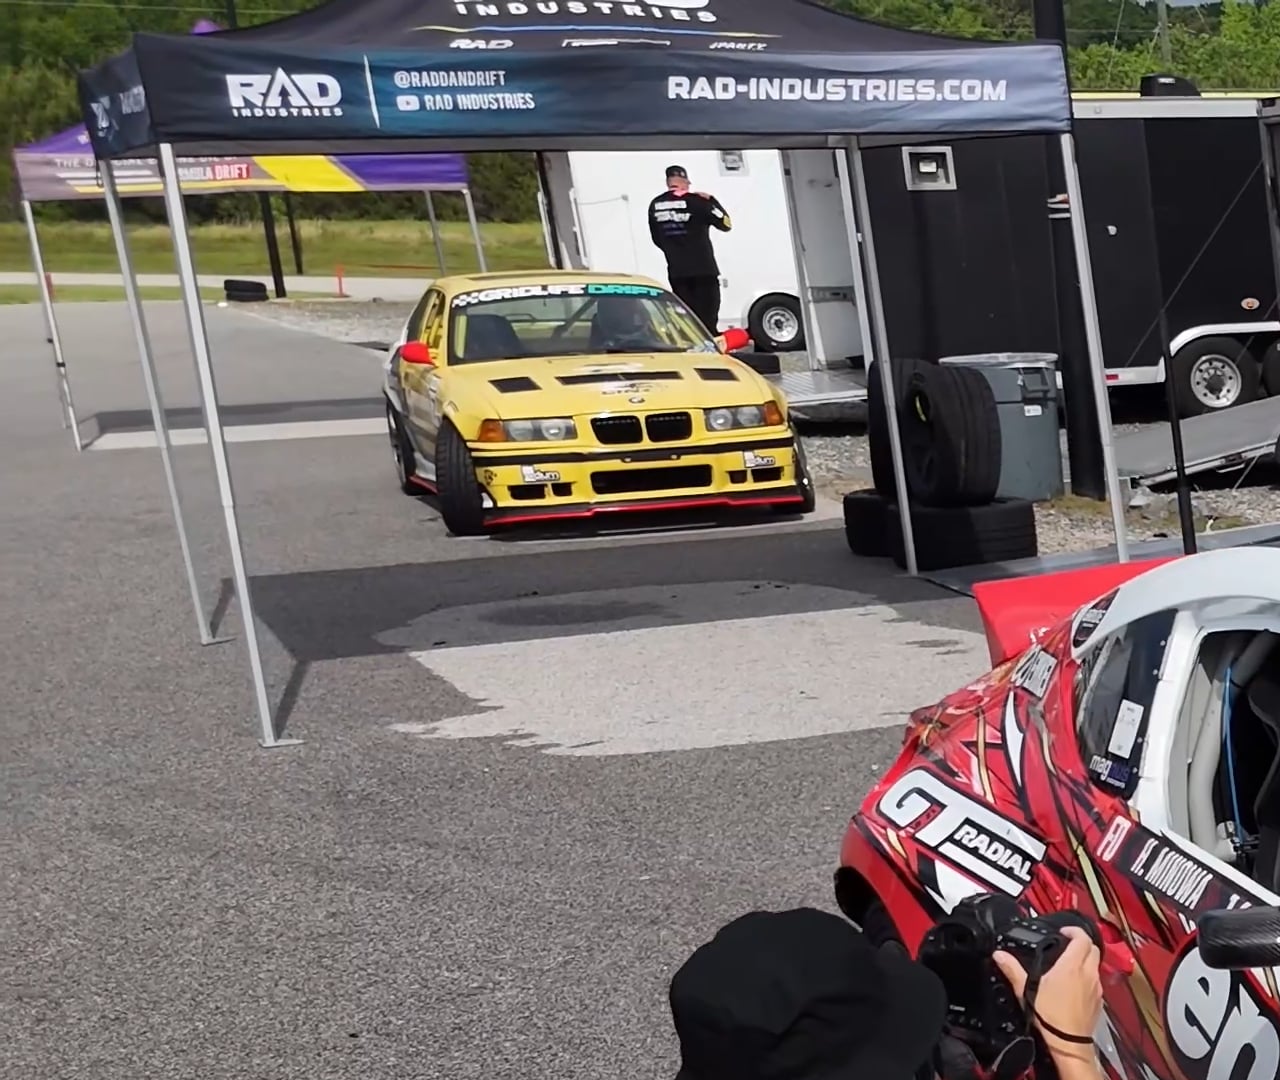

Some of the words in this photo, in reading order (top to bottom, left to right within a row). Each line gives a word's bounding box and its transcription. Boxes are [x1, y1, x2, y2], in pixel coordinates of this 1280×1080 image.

[454, 1, 717, 23] INDUSTRIES
[225, 67, 343, 107] RAD
[394, 70, 506, 88] @RADDANDRIFT
[667, 76, 1007, 101] RAD-INDUSTRIES.COM
[424, 95, 453, 111] RAD
[457, 93, 536, 111] INDUSTRIES
[231, 107, 343, 118] INDUSTRIES
[214, 164, 249, 180] DRIFT
[478, 284, 587, 302] GRIDLIFE
[588, 284, 664, 297] DRIFT
[953, 823, 1032, 882] RADIAL
[1145, 846, 1214, 911] MINOWA
